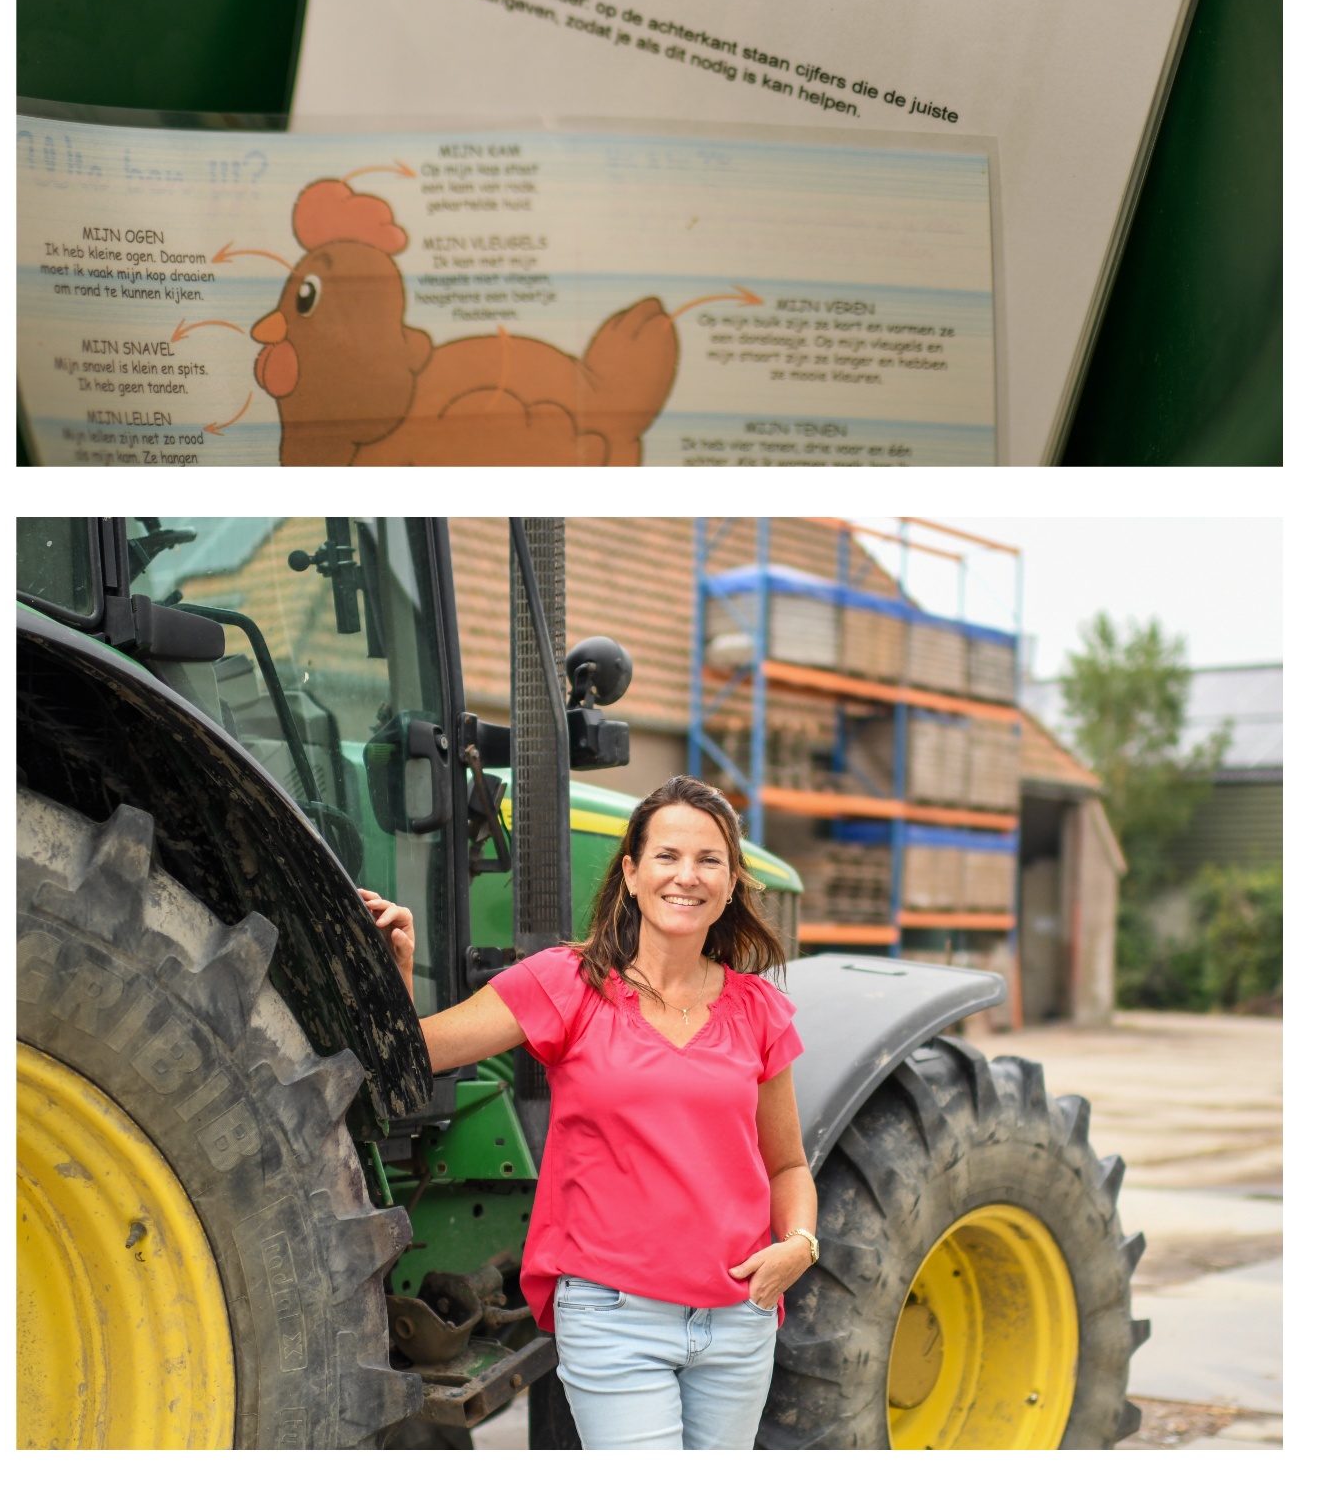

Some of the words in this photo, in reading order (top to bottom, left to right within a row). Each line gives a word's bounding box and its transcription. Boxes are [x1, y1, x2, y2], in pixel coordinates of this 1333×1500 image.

[565, 14, 612, 40] zodat
[614, 28, 631, 46] je
[636, 36, 660, 55] als
[665, 45, 685, 64] dit
[690, 52, 737, 81] nodig
[742, 68, 756, 84] is
[762, 74, 793, 96] kan
[798, 85, 861, 118] helpen.
[595, 2, 616, 19] op
[621, 8, 642, 26] de
[648, 17, 737, 55] achterkant
[742, 46, 790, 72] staan
[795, 63, 847, 89] cijfers
[852, 80, 879, 99] die
[883, 89, 906, 108] de
[908, 97, 959, 124] juiste
[82, 227, 120, 243] MIJN
[125, 229, 164, 244] OGEN
[45, 243, 59, 256] Ik
[63, 244, 84, 259] heb
[88, 246, 123, 261] kleine
[126, 251, 156, 265] ogen.
[160, 250, 206, 264] Daarom
[40, 265, 69, 275] moet
[74, 264, 84, 277] ik
[87, 266, 113, 279] vaak
[117, 269, 142, 284] mijn
[146, 270, 166, 284] kop
[170, 269, 215, 282] draaien
[54, 285, 71, 295] om
[74, 283, 101, 297] rond
[104, 285, 116, 297] te
[121, 285, 161, 299] kunnen
[165, 287, 204, 303] kijken.
[82, 339, 118, 355] MIJN
[123, 342, 175, 357] SNAVEL
[54, 357, 79, 374] Mijn
[82, 360, 115, 374] snavel
[119, 362, 128, 373] is
[131, 362, 158, 374] klein
[161, 365, 174, 375] en
[177, 363, 208, 378] spits.
[78, 377, 91, 391] Ik
[95, 379, 114, 392] heb
[118, 382, 144, 396] geen
[147, 381, 188, 394] tanden.
[86, 410, 122, 425] MIJN
[125, 411, 171, 426] LELLEN
[119, 433, 139, 448] zijn
[142, 433, 159, 444] net
[163, 435, 175, 445] zo
[179, 432, 204, 445] rood
